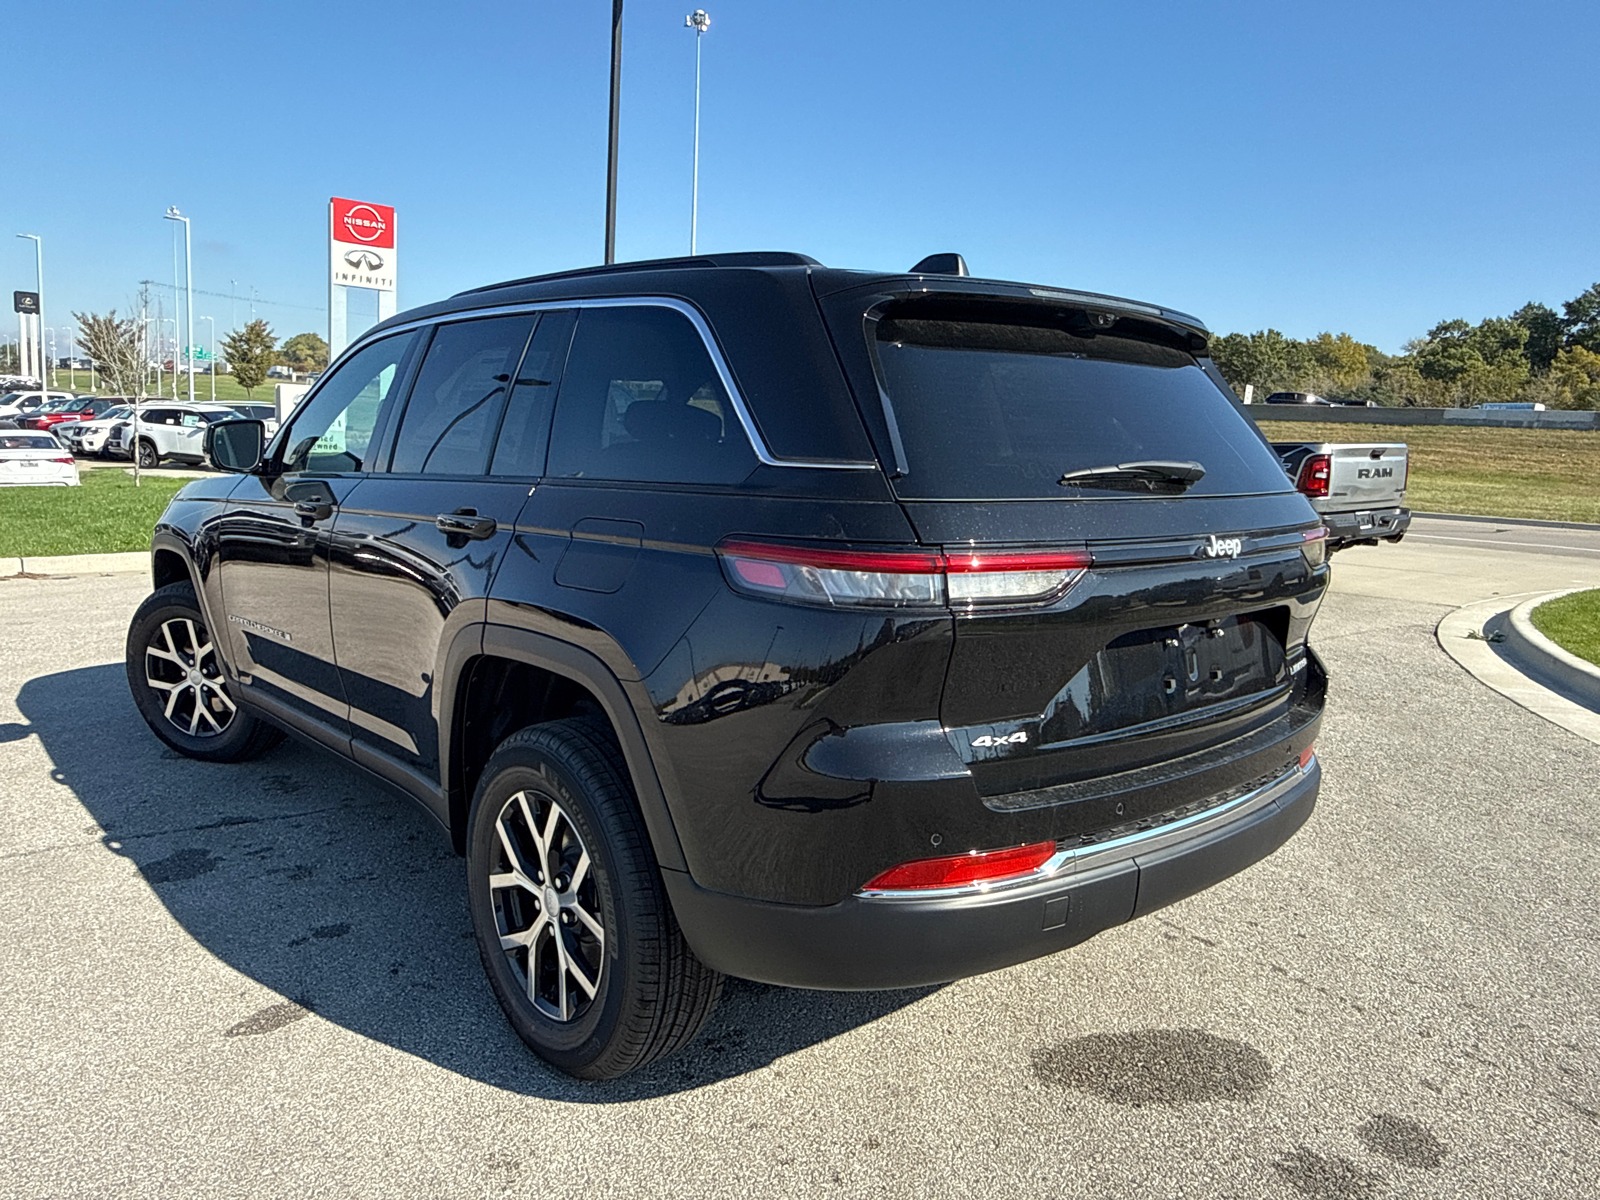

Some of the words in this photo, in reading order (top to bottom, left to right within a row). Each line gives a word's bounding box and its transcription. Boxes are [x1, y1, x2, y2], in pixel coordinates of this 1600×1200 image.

[344, 217, 385, 230] NISSAN
[335, 272, 392, 287] INFINITI
[1358, 468, 1393, 479] RAM
[1206, 535, 1241, 558] Jeep
[971, 731, 1028, 747] 4x4
[560, 786, 602, 864] MICHELIN
